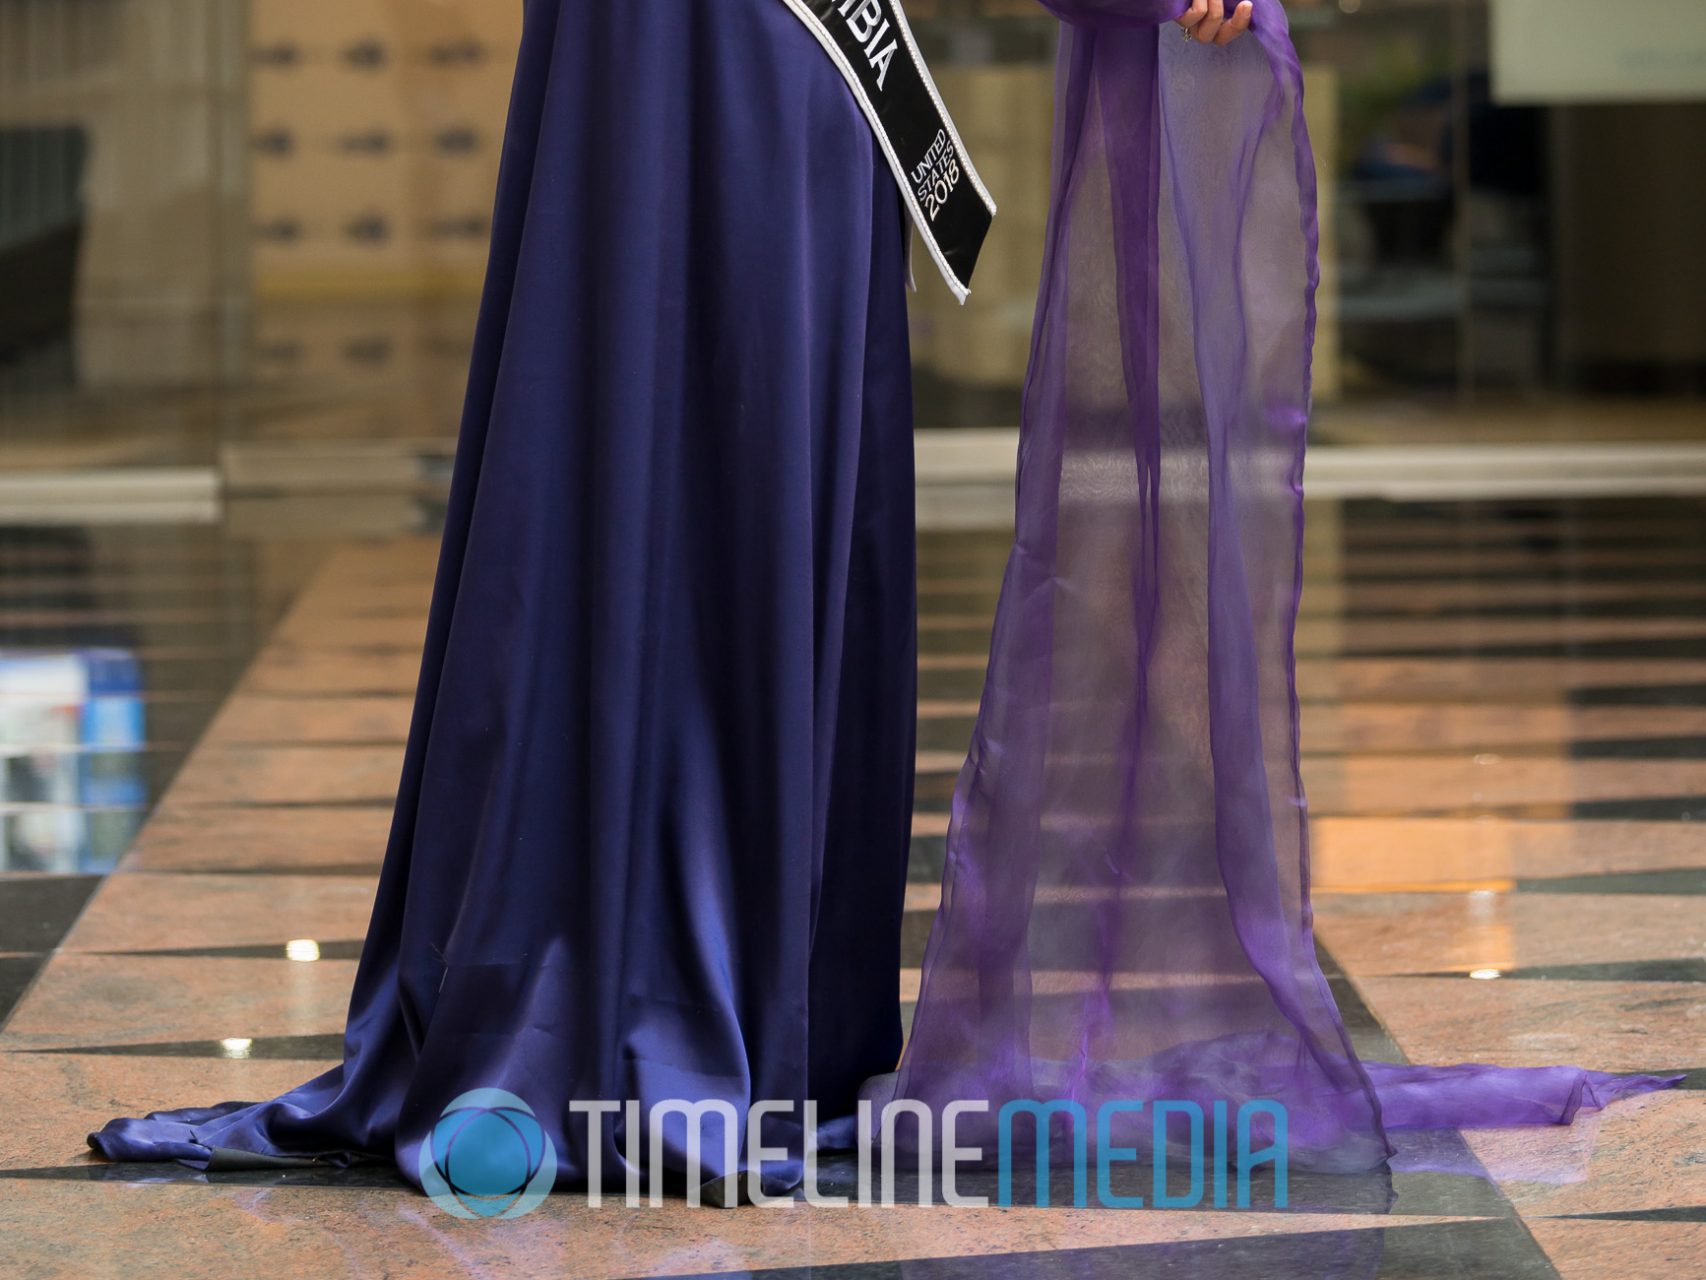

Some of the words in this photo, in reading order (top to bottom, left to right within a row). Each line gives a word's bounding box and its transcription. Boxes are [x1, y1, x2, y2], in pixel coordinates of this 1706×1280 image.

[911, 129, 946, 183] UNITED
[918, 140, 954, 201] STATES
[925, 159, 960, 221] 2018
